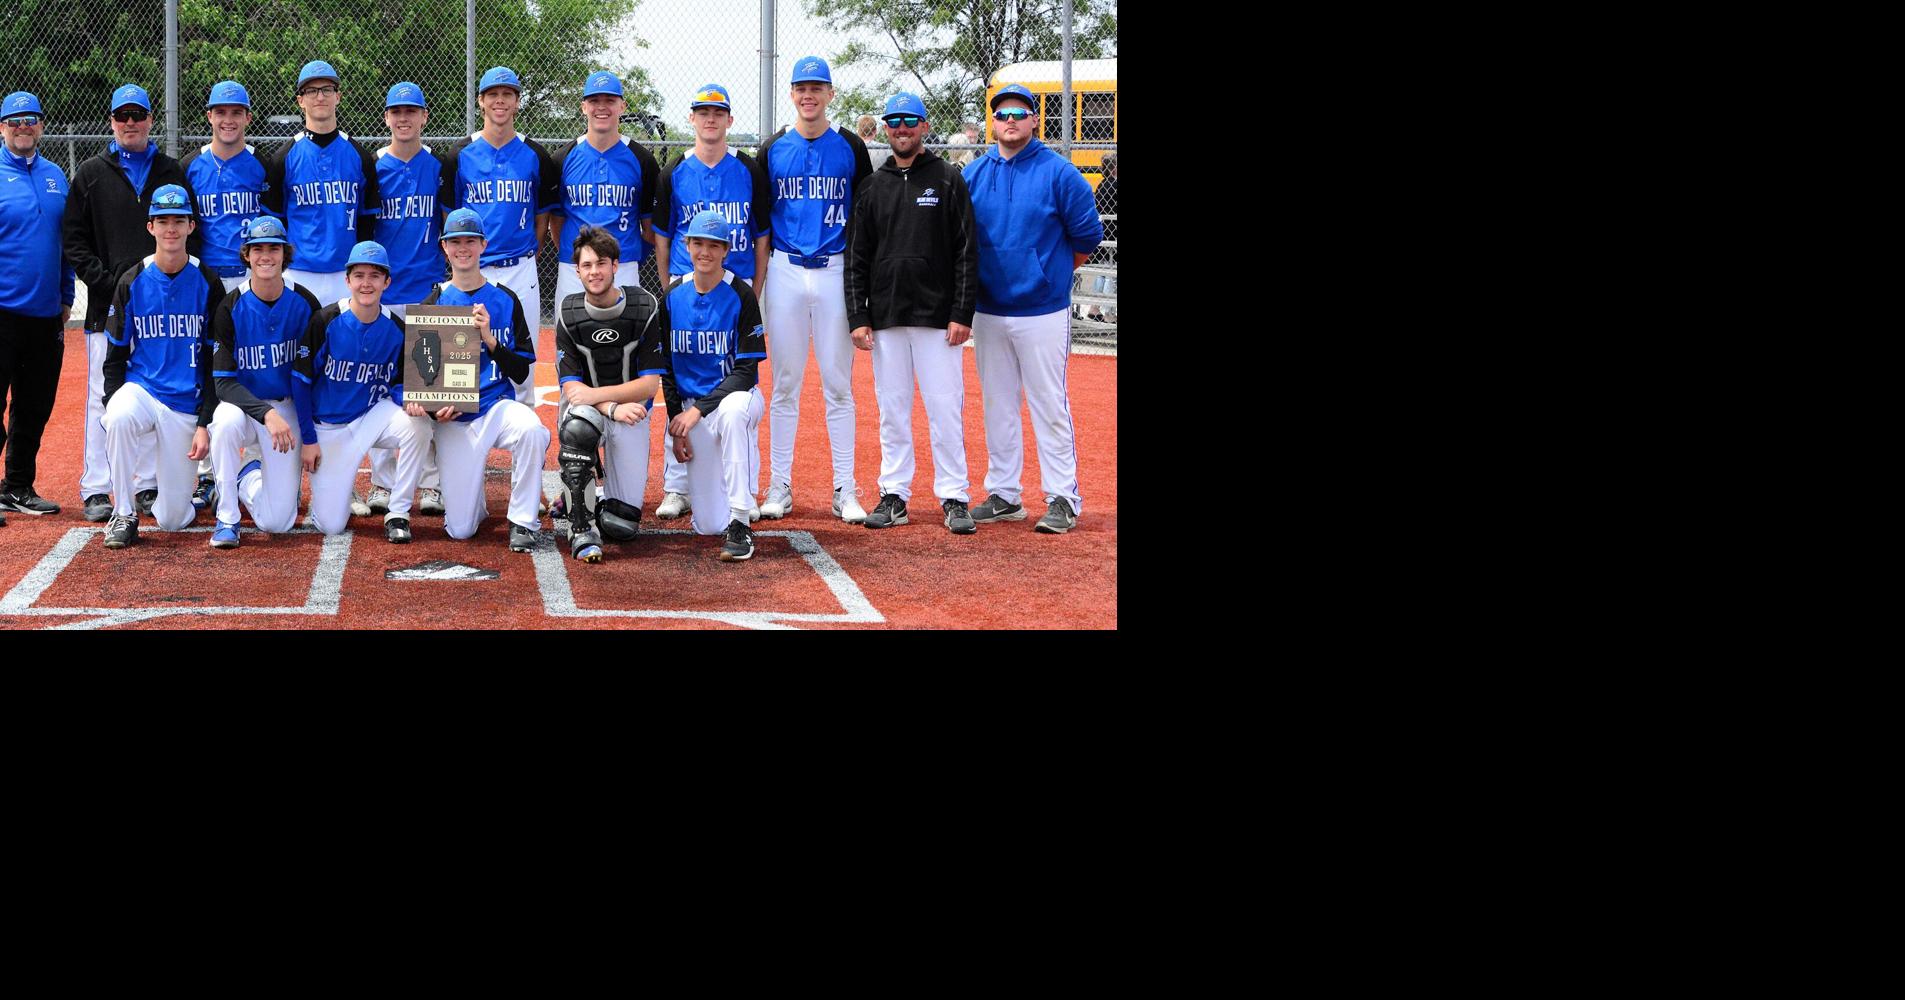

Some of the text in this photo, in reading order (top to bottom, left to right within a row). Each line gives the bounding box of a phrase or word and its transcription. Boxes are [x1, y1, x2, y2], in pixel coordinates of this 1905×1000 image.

[293, 181, 358, 206] BLUE DEVILS
[466, 180, 532, 204] BLUE DEVILS
[566, 184, 636, 207] BLUE DEVILS
[777, 176, 846, 200] BLUE DEVILS
[197, 192, 260, 217] LUE DEVILS
[405, 196, 434, 218] DEVIL
[824, 204, 846, 228] 44
[346, 208, 355, 231] 1
[520, 208, 527, 230] 4
[619, 212, 629, 232] 5
[730, 228, 748, 252] 15
[134, 314, 204, 338] BLUE DEVILS
[415, 316, 473, 324] REGIONAL
[670, 330, 692, 354] LUE
[238, 339, 296, 370] BLUE DEVIL
[450, 352, 472, 360] 2025
[324, 354, 354, 382] BLUE
[407, 392, 476, 400] CHAMPIONS
